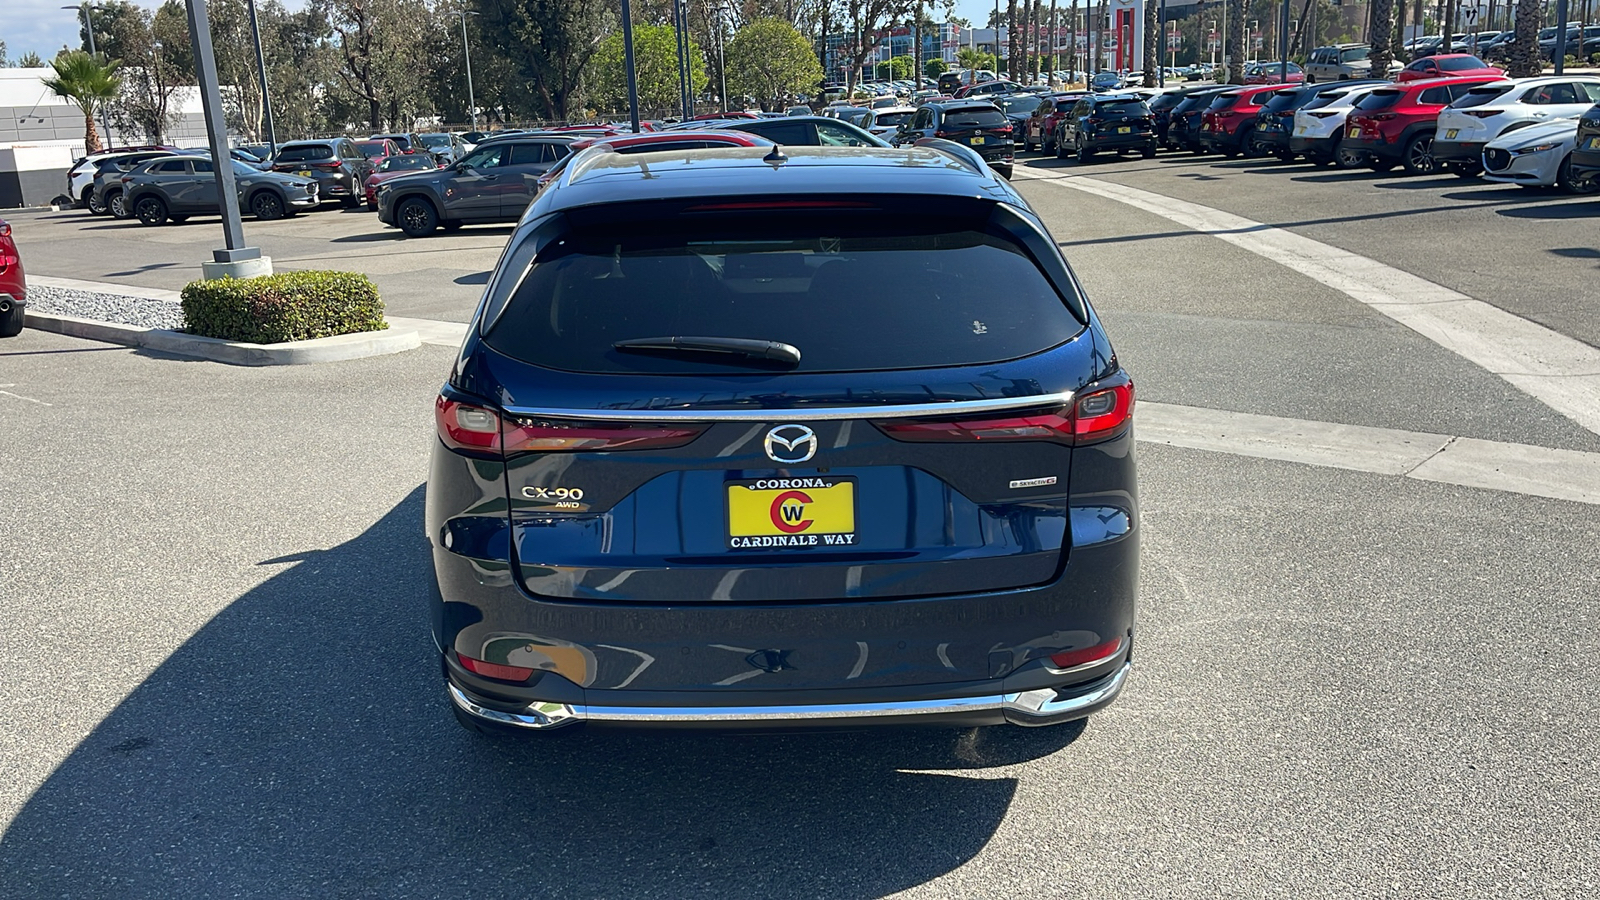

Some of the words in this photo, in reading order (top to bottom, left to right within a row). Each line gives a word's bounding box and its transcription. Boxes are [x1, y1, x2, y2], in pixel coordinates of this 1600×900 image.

[756, 478, 824, 489] CORONA
[521, 486, 584, 500] CX-90
[555, 501, 580, 509] AWD
[770, 490, 814, 533] C
[782, 504, 805, 522] W
[730, 535, 818, 548] CARDINALE
[823, 534, 855, 545] WAY
